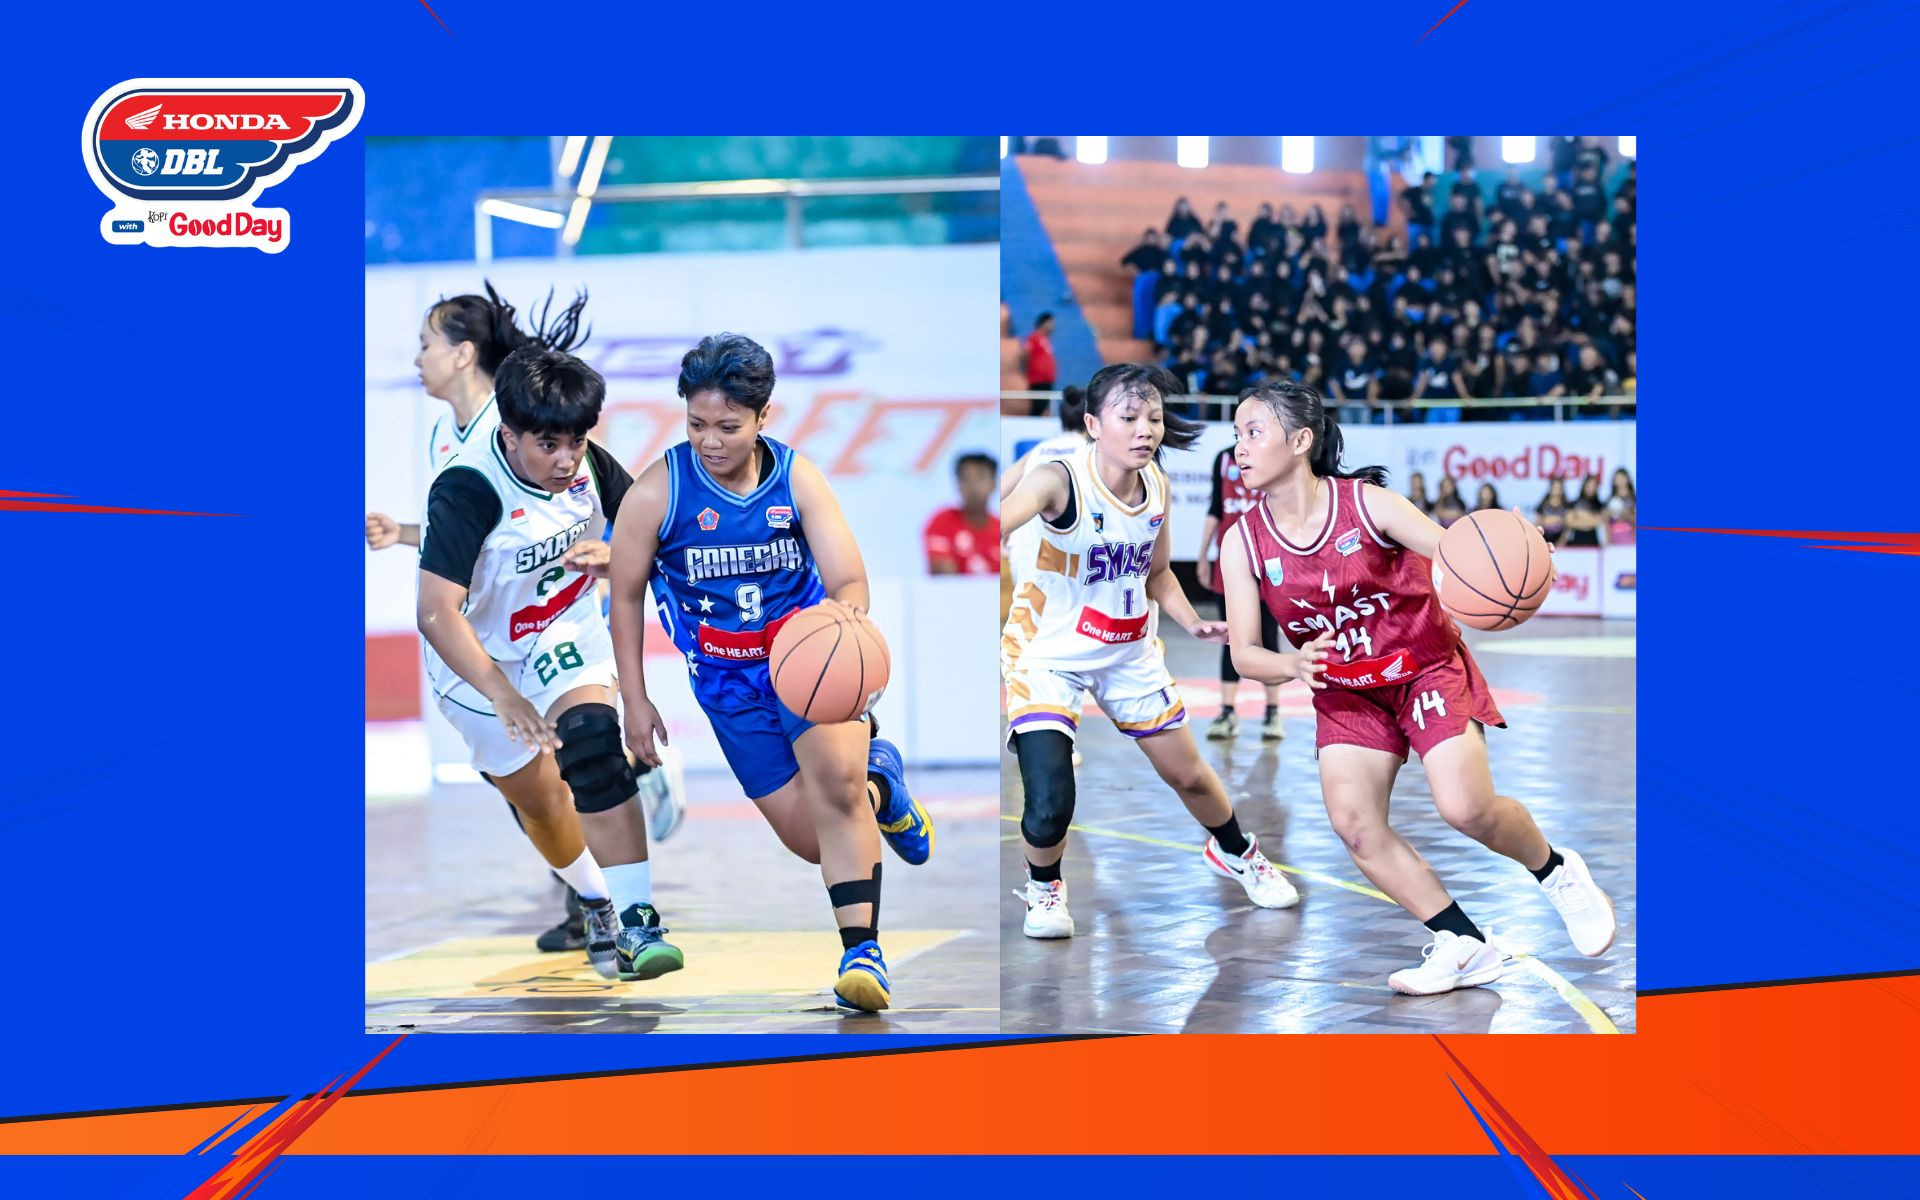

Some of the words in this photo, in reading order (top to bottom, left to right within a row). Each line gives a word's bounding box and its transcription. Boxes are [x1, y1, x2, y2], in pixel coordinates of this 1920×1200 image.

[1444, 443, 1531, 481] Good
[1536, 444, 1605, 486] Day
[685, 537, 804, 586] GANESHA
[735, 583, 763, 623] 9
[1123, 588, 1134, 616] 1
[1288, 592, 1390, 634] SMAST
[703, 642, 726, 656] One
[1081, 621, 1102, 637] One
[1335, 626, 1373, 662] 14
[533, 641, 584, 687] 28
[1412, 689, 1447, 730] 14
